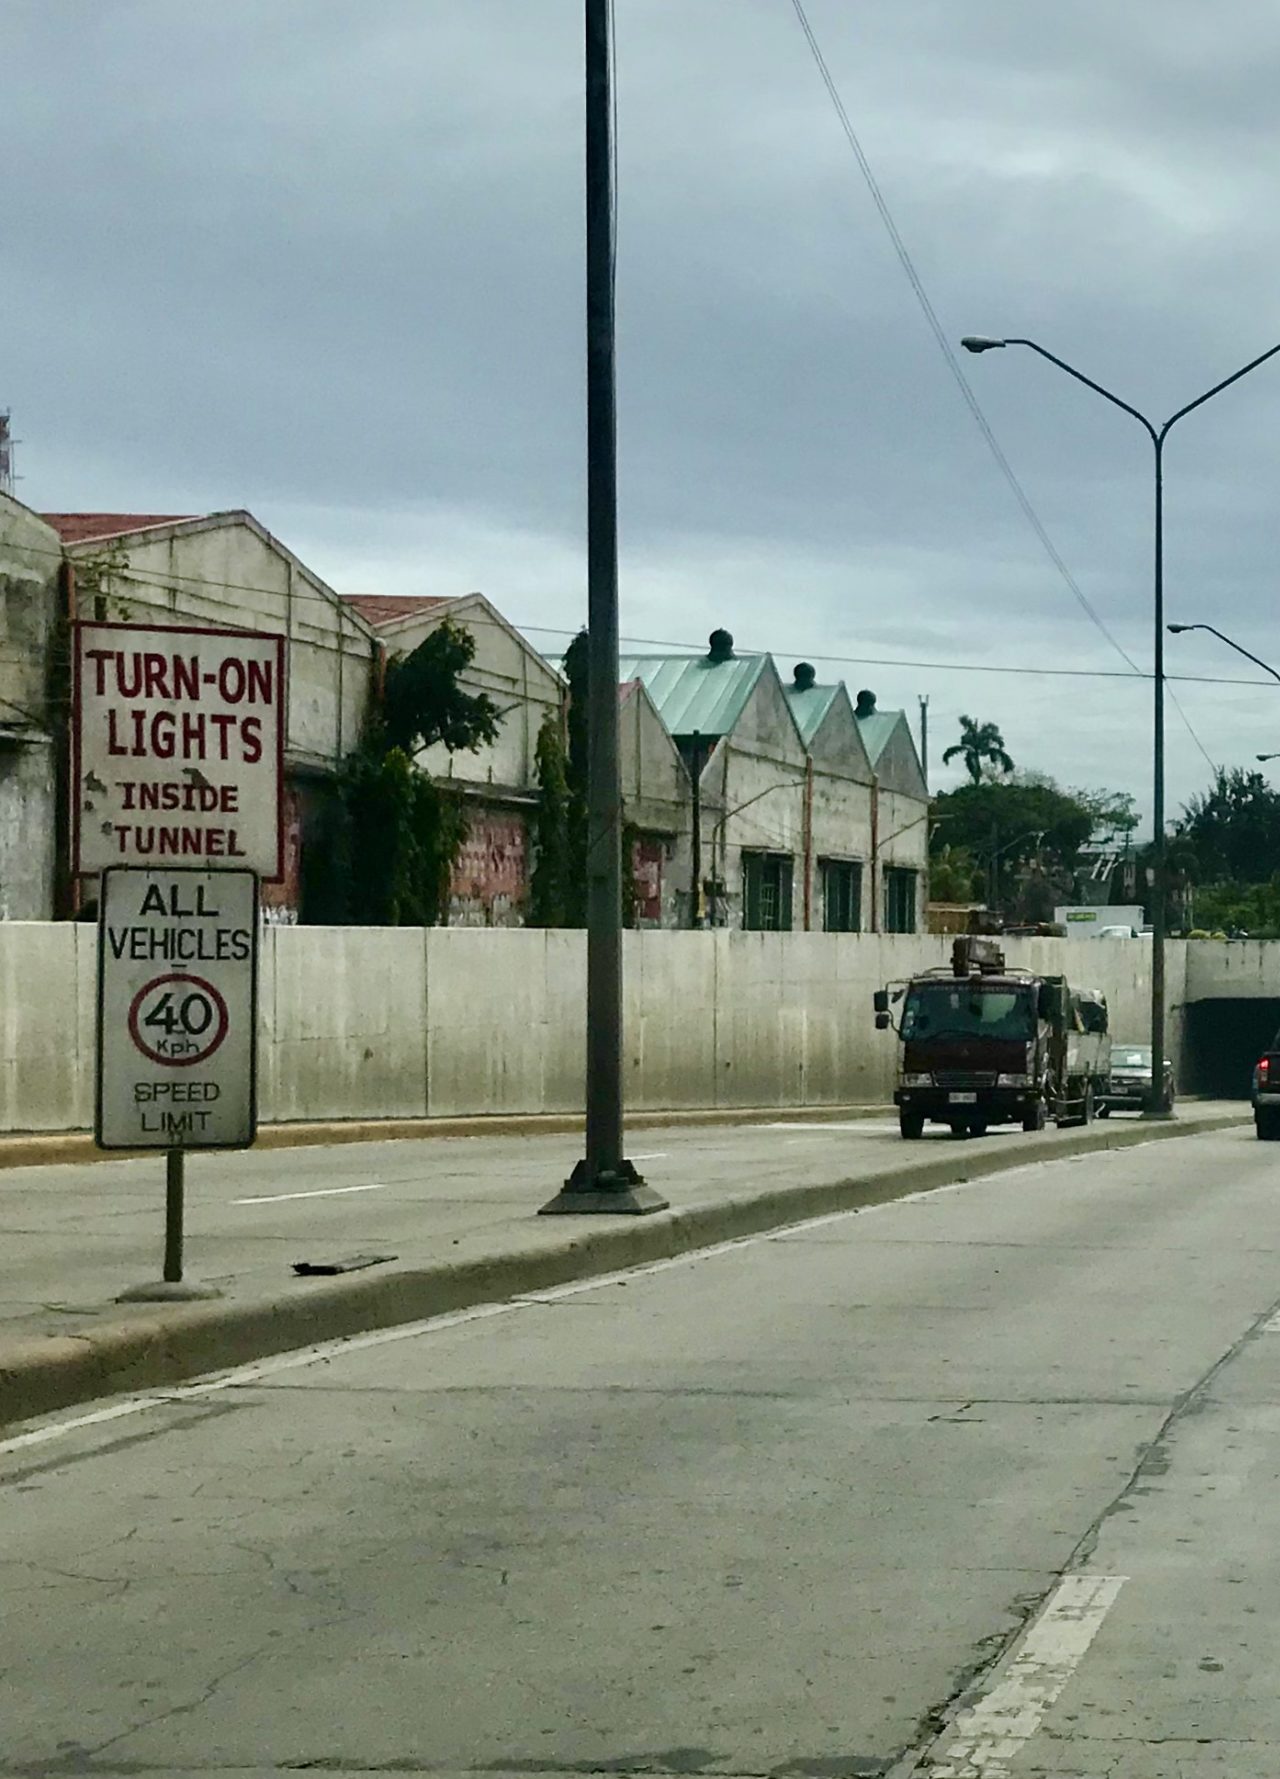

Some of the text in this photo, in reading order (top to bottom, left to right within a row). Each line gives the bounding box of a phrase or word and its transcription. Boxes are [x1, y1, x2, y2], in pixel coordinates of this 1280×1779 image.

[86, 650, 273, 705] TURN-ON
[107, 709, 262, 763] LIGHTS
[121, 781, 239, 813] INSIDE
[114, 826, 246, 857] TUNNEL
[140, 885, 219, 918] ALL
[108, 927, 250, 961] VEHICLES
[144, 992, 213, 1035] 40
[133, 1081, 220, 1104] SPEED
[141, 1111, 212, 1132] LIMIT
